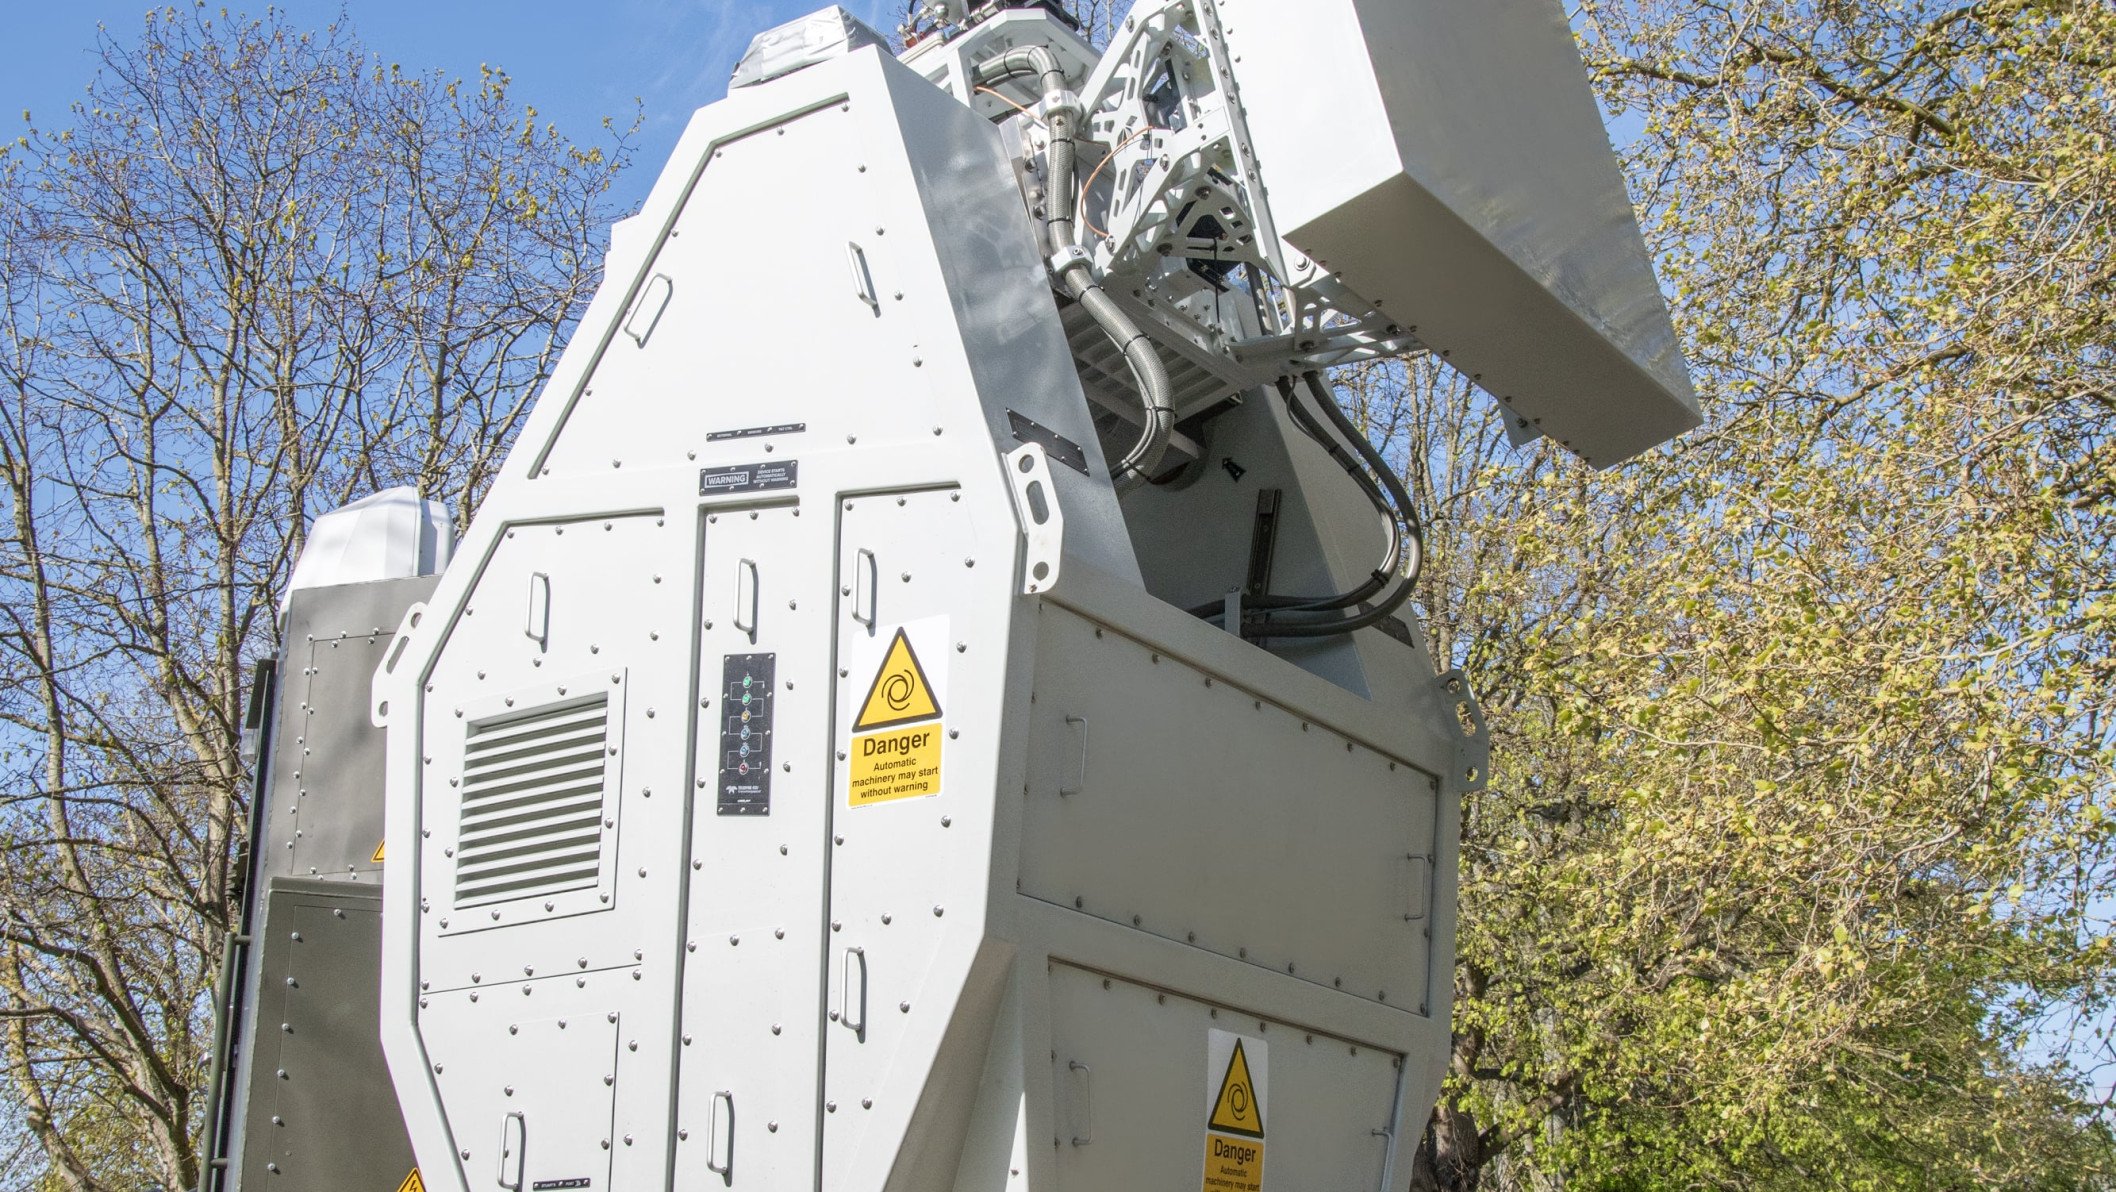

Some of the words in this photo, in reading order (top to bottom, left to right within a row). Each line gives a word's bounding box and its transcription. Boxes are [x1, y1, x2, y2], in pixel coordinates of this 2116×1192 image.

[708, 474, 746, 485] WARNING
[864, 733, 930, 756] Danger
[873, 757, 917, 771] Automatic
[852, 774, 896, 787] machinery
[898, 770, 916, 780] may
[918, 766, 938, 777] start
[860, 786, 892, 798] without
[894, 781, 928, 793] warning
[1214, 1139, 1256, 1165] Danger
[1220, 1165, 1247, 1177] Automatic
[1205, 1177, 1234, 1189] machinery
[1234, 1181, 1246, 1191] may
[1247, 1182, 1260, 1192] start
